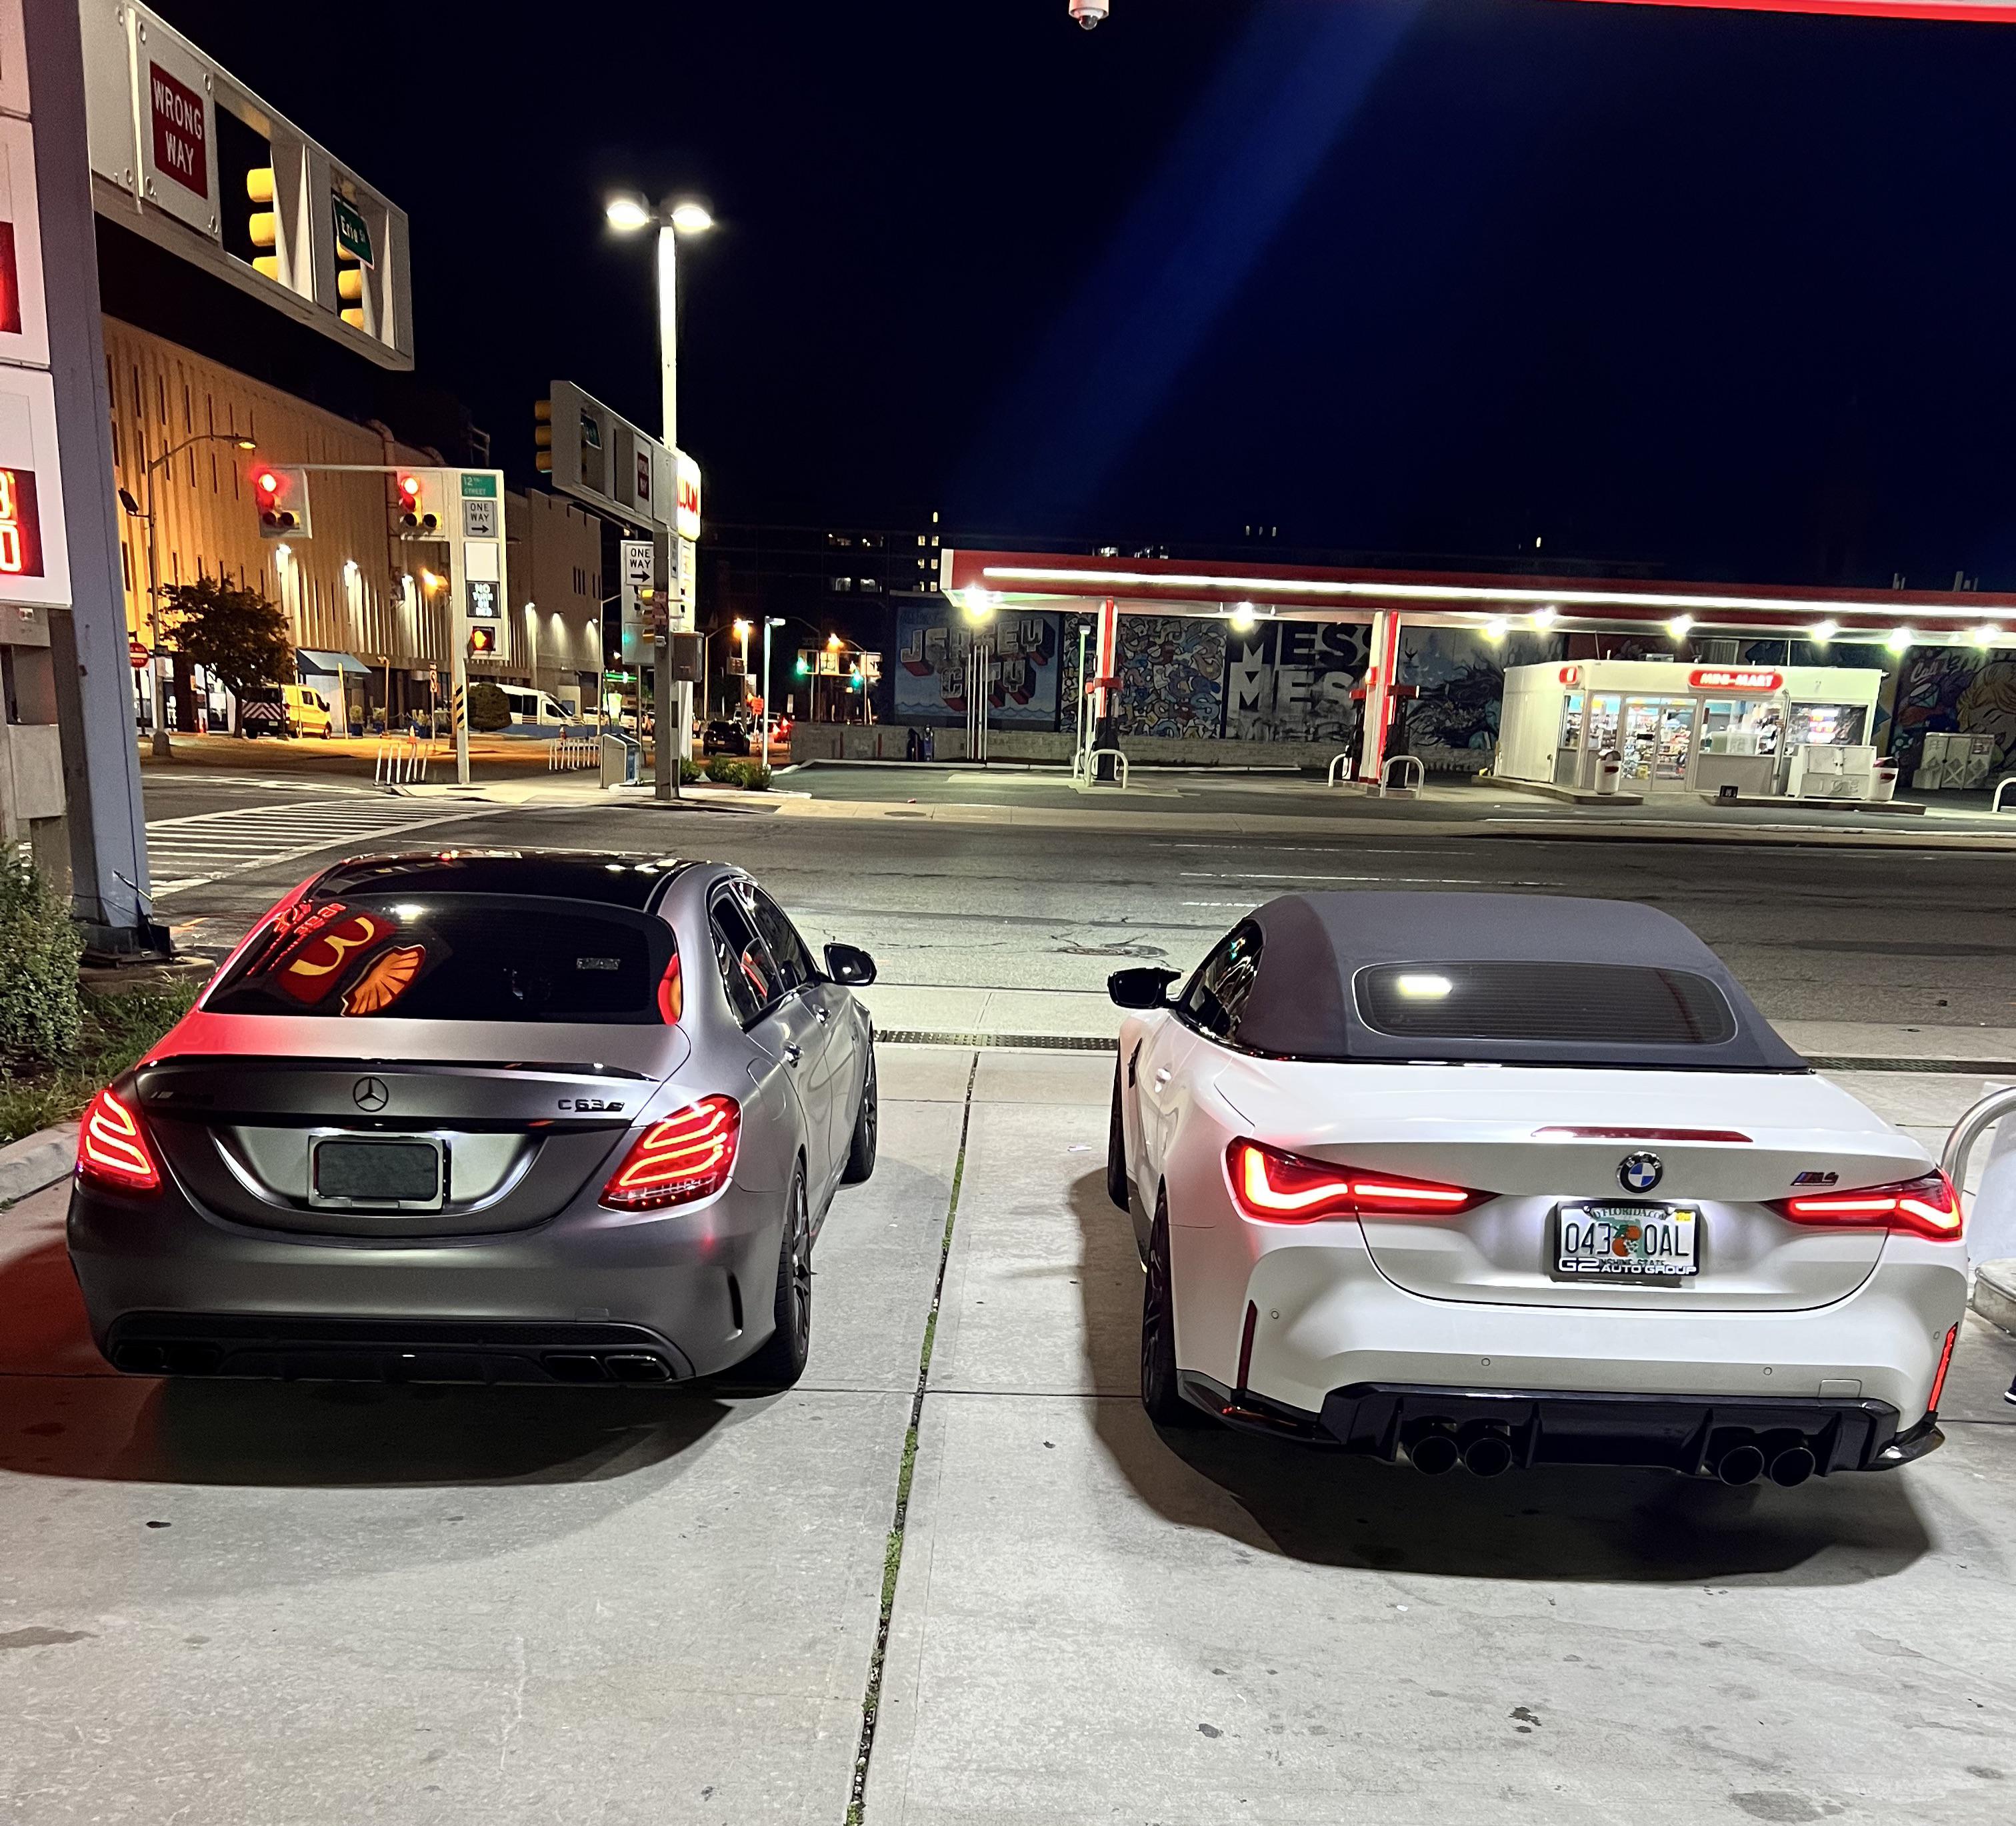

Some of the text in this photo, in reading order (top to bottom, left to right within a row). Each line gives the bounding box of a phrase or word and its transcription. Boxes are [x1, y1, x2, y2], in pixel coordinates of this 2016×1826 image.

[153, 77, 203, 140] WRONG
[165, 131, 194, 176] WAY
[464, 487, 486, 495] STREET
[471, 503, 489, 512] ONE
[471, 513, 489, 522] WAY
[631, 548, 651, 558] ONE
[630, 559, 651, 569] WAY
[475, 583, 491, 593] NO
[900, 618, 1044, 663] JERSEY
[941, 659, 1026, 699] CTY
[1566, 1223, 1611, 1254] 043
[1559, 1257, 1697, 1275] G2 AUTO GROUP
